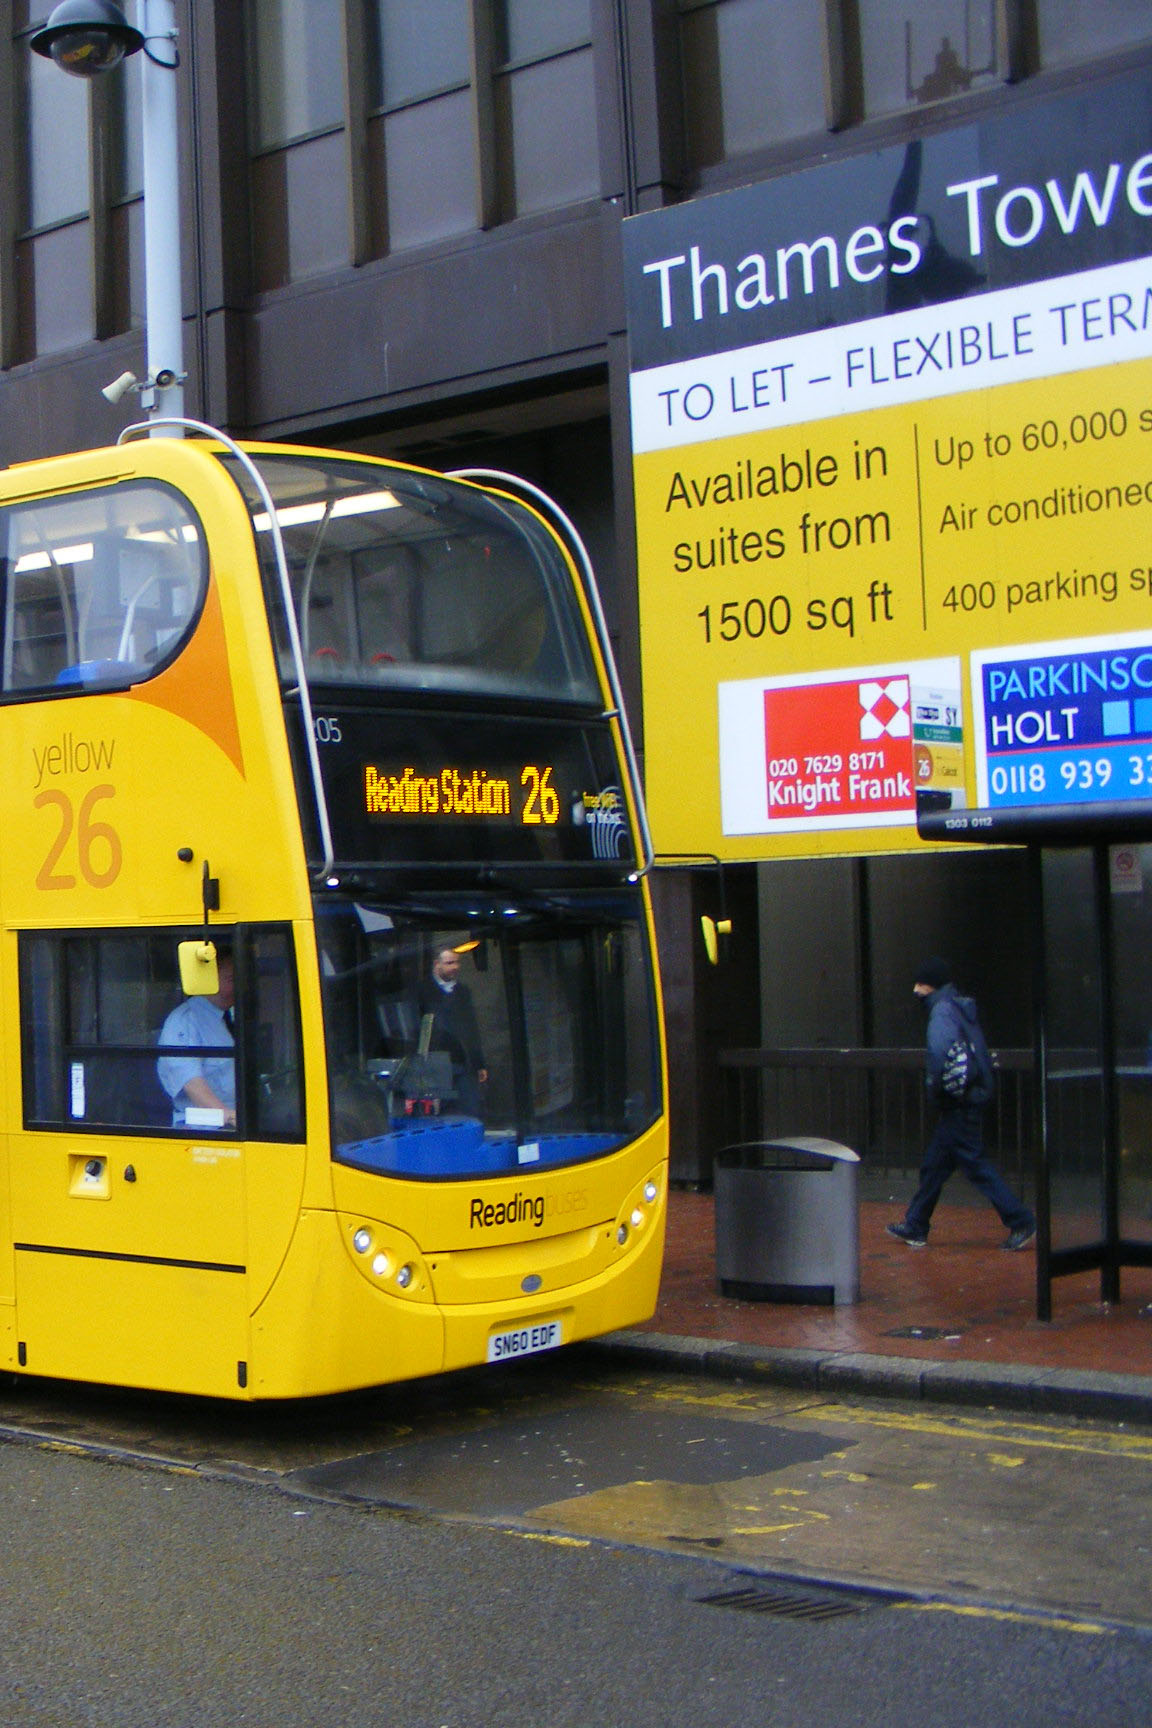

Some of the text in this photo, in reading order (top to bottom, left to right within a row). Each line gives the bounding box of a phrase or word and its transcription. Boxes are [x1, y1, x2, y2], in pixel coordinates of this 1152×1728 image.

[643, 151, 1152, 329] Thames Towe
[657, 382, 714, 427] TO
[729, 363, 795, 413] LET
[846, 313, 1033, 389] FLEXIBLE
[934, 435, 974, 470] Up
[983, 432, 1011, 459] to
[1022, 407, 1127, 452] 60,000
[665, 440, 888, 513] Available in
[939, 502, 978, 534] Air
[672, 509, 891, 573] suites from
[697, 580, 894, 643] 1500 sq ft
[942, 567, 1152, 614] 400 parking s
[313, 716, 342, 743] 05
[992, 707, 1079, 746] HOLT
[32, 732, 115, 789] yellow
[768, 751, 885, 777] 020 7629 8171
[917, 759, 931, 777] 26
[991, 763, 1046, 795] 0118
[1059, 758, 1113, 790] 939
[365, 766, 560, 824] Reading Station 26
[767, 771, 912, 811] Knight Frank
[33, 783, 123, 891] 26
[971, 816, 993, 828] 0112
[469, 1191, 545, 1230] Reading
[493, 1324, 557, 1357] SN60 EDF
